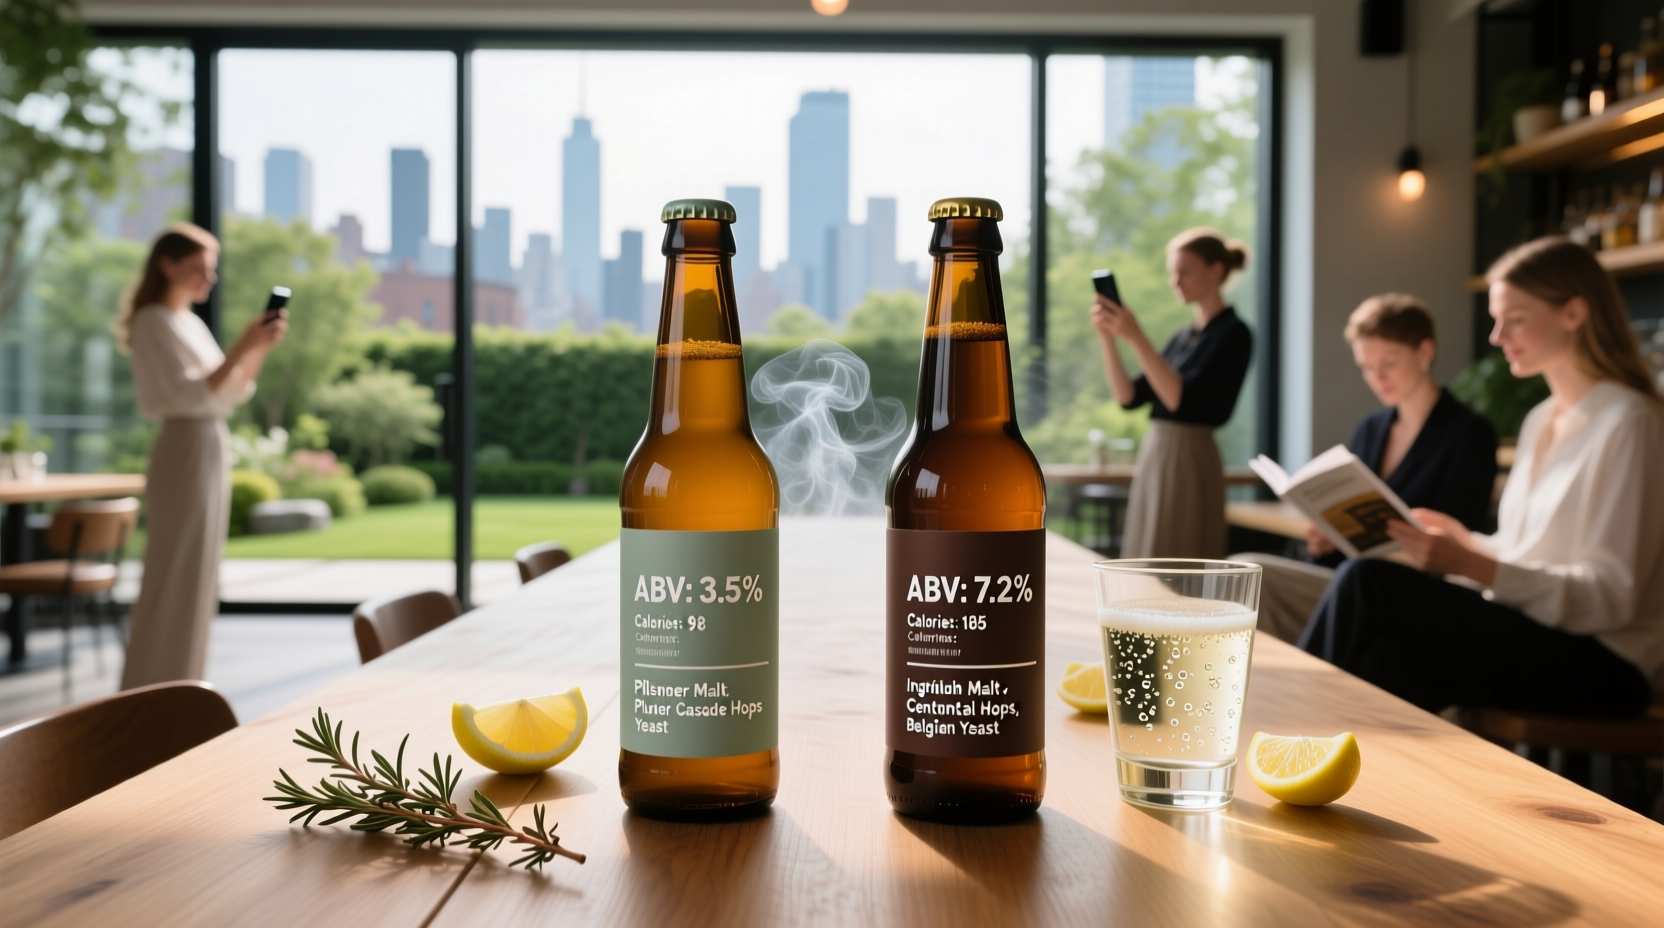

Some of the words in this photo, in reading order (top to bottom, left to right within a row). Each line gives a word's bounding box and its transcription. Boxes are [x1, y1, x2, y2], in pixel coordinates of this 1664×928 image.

[634, 575, 692, 603] ABV:
[699, 575, 763, 604] 3.5%
[907, 574, 967, 603] ABV:
[974, 574, 1033, 603] 7.2%
[688, 615, 706, 631] 98
[731, 700, 763, 720] Hops
[980, 701, 1020, 720] Hops,
[635, 717, 669, 733] Yeast
[961, 721, 1000, 735] Yeast
